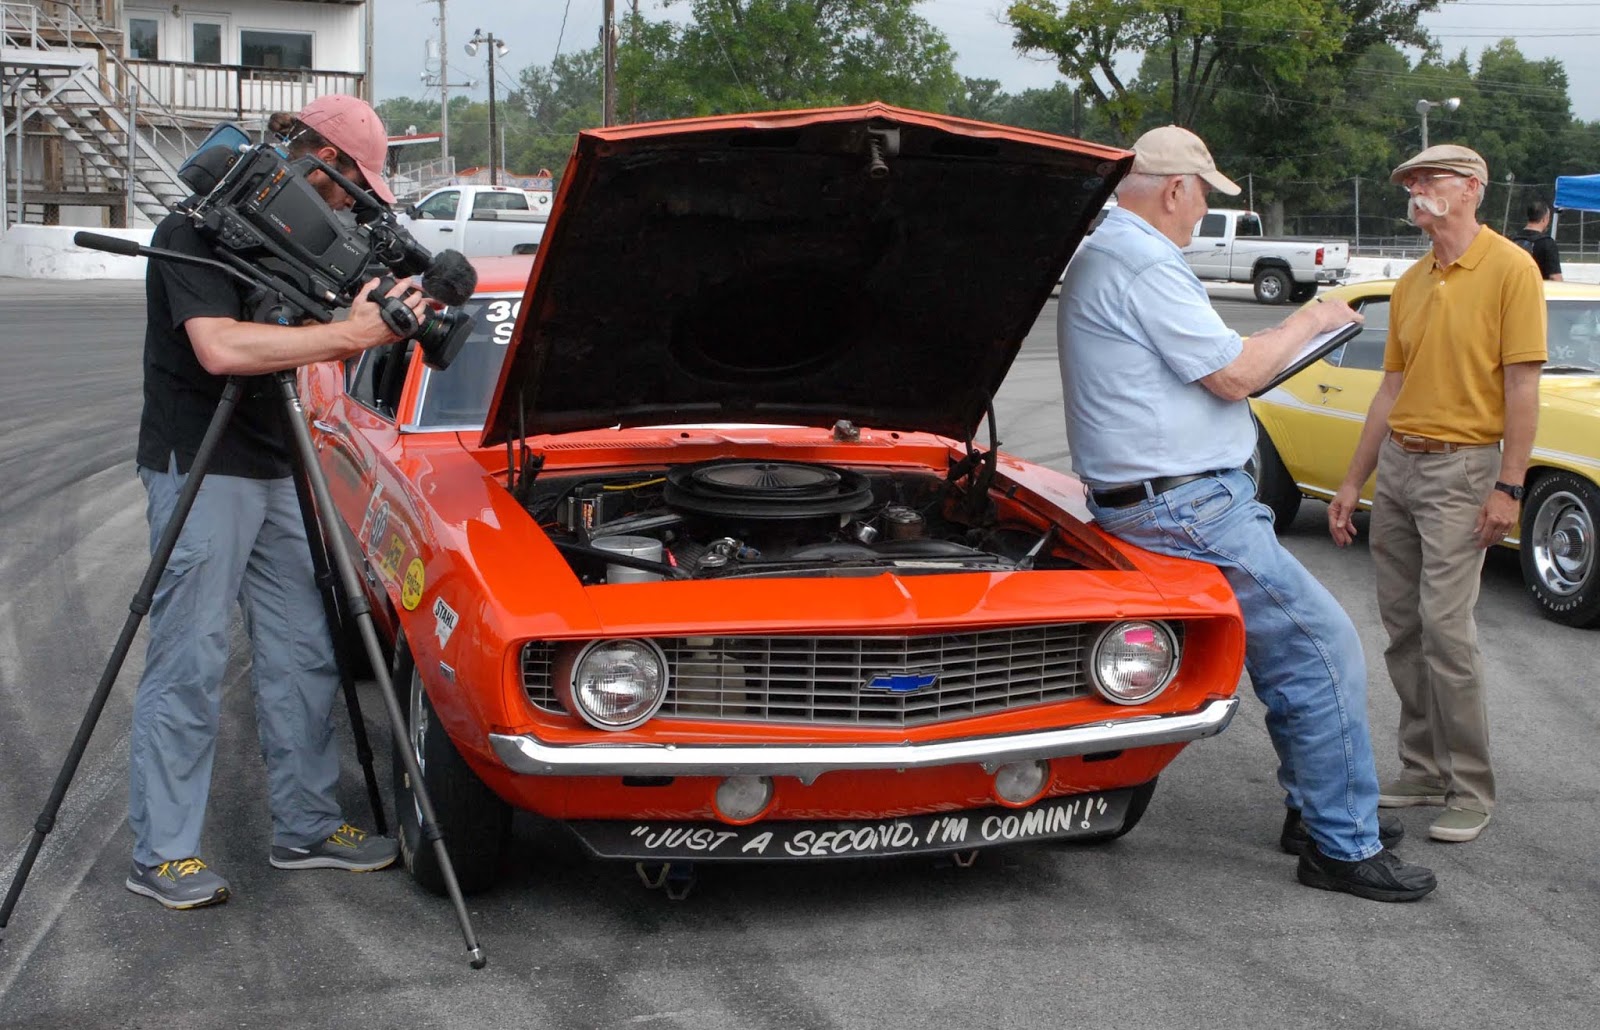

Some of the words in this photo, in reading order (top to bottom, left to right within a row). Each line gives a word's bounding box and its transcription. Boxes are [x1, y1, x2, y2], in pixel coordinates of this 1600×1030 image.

[342, 242, 361, 256] SONY
[435, 600, 455, 630] STAHL
[741, 831, 774, 855] A
[784, 822, 919, 856] SECOND,
[926, 816, 969, 845] I'M
